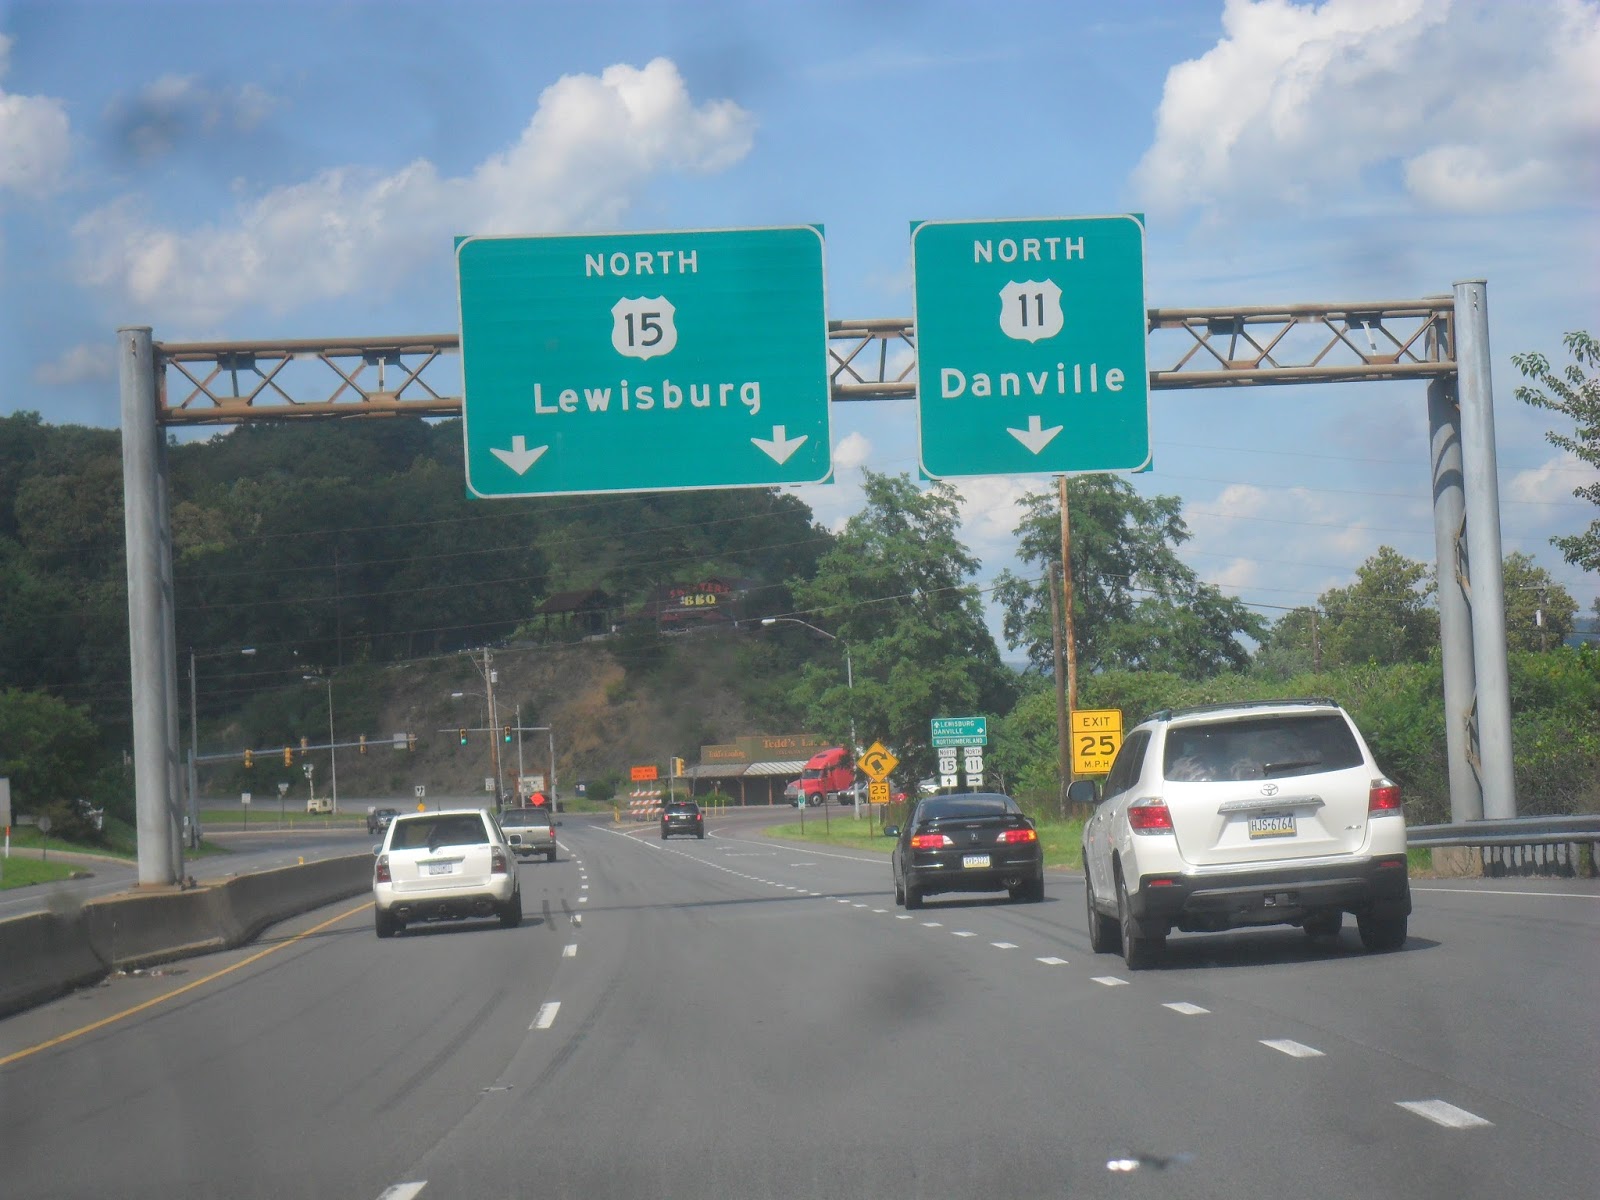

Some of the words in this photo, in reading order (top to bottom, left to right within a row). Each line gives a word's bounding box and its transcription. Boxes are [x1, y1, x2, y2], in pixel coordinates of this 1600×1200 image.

[974, 236, 1085, 263] NORTH
[585, 250, 698, 277] NORTH
[1018, 293, 1044, 327] 11
[624, 312, 663, 347] 15
[940, 362, 1125, 398] Danville
[533, 379, 761, 415] Lewisburg
[684, 594, 716, 606] BBQ
[940, 720, 975, 728] LEWISBURG
[1083, 717, 1110, 727] EXIT
[762, 738, 796, 749] Tedd's
[935, 737, 983, 746] NORTHUMBERLAND
[1080, 735, 1115, 756] 25
[942, 760, 954, 771] 15
[969, 760, 979, 770] 11
[871, 785, 887, 795] 25
